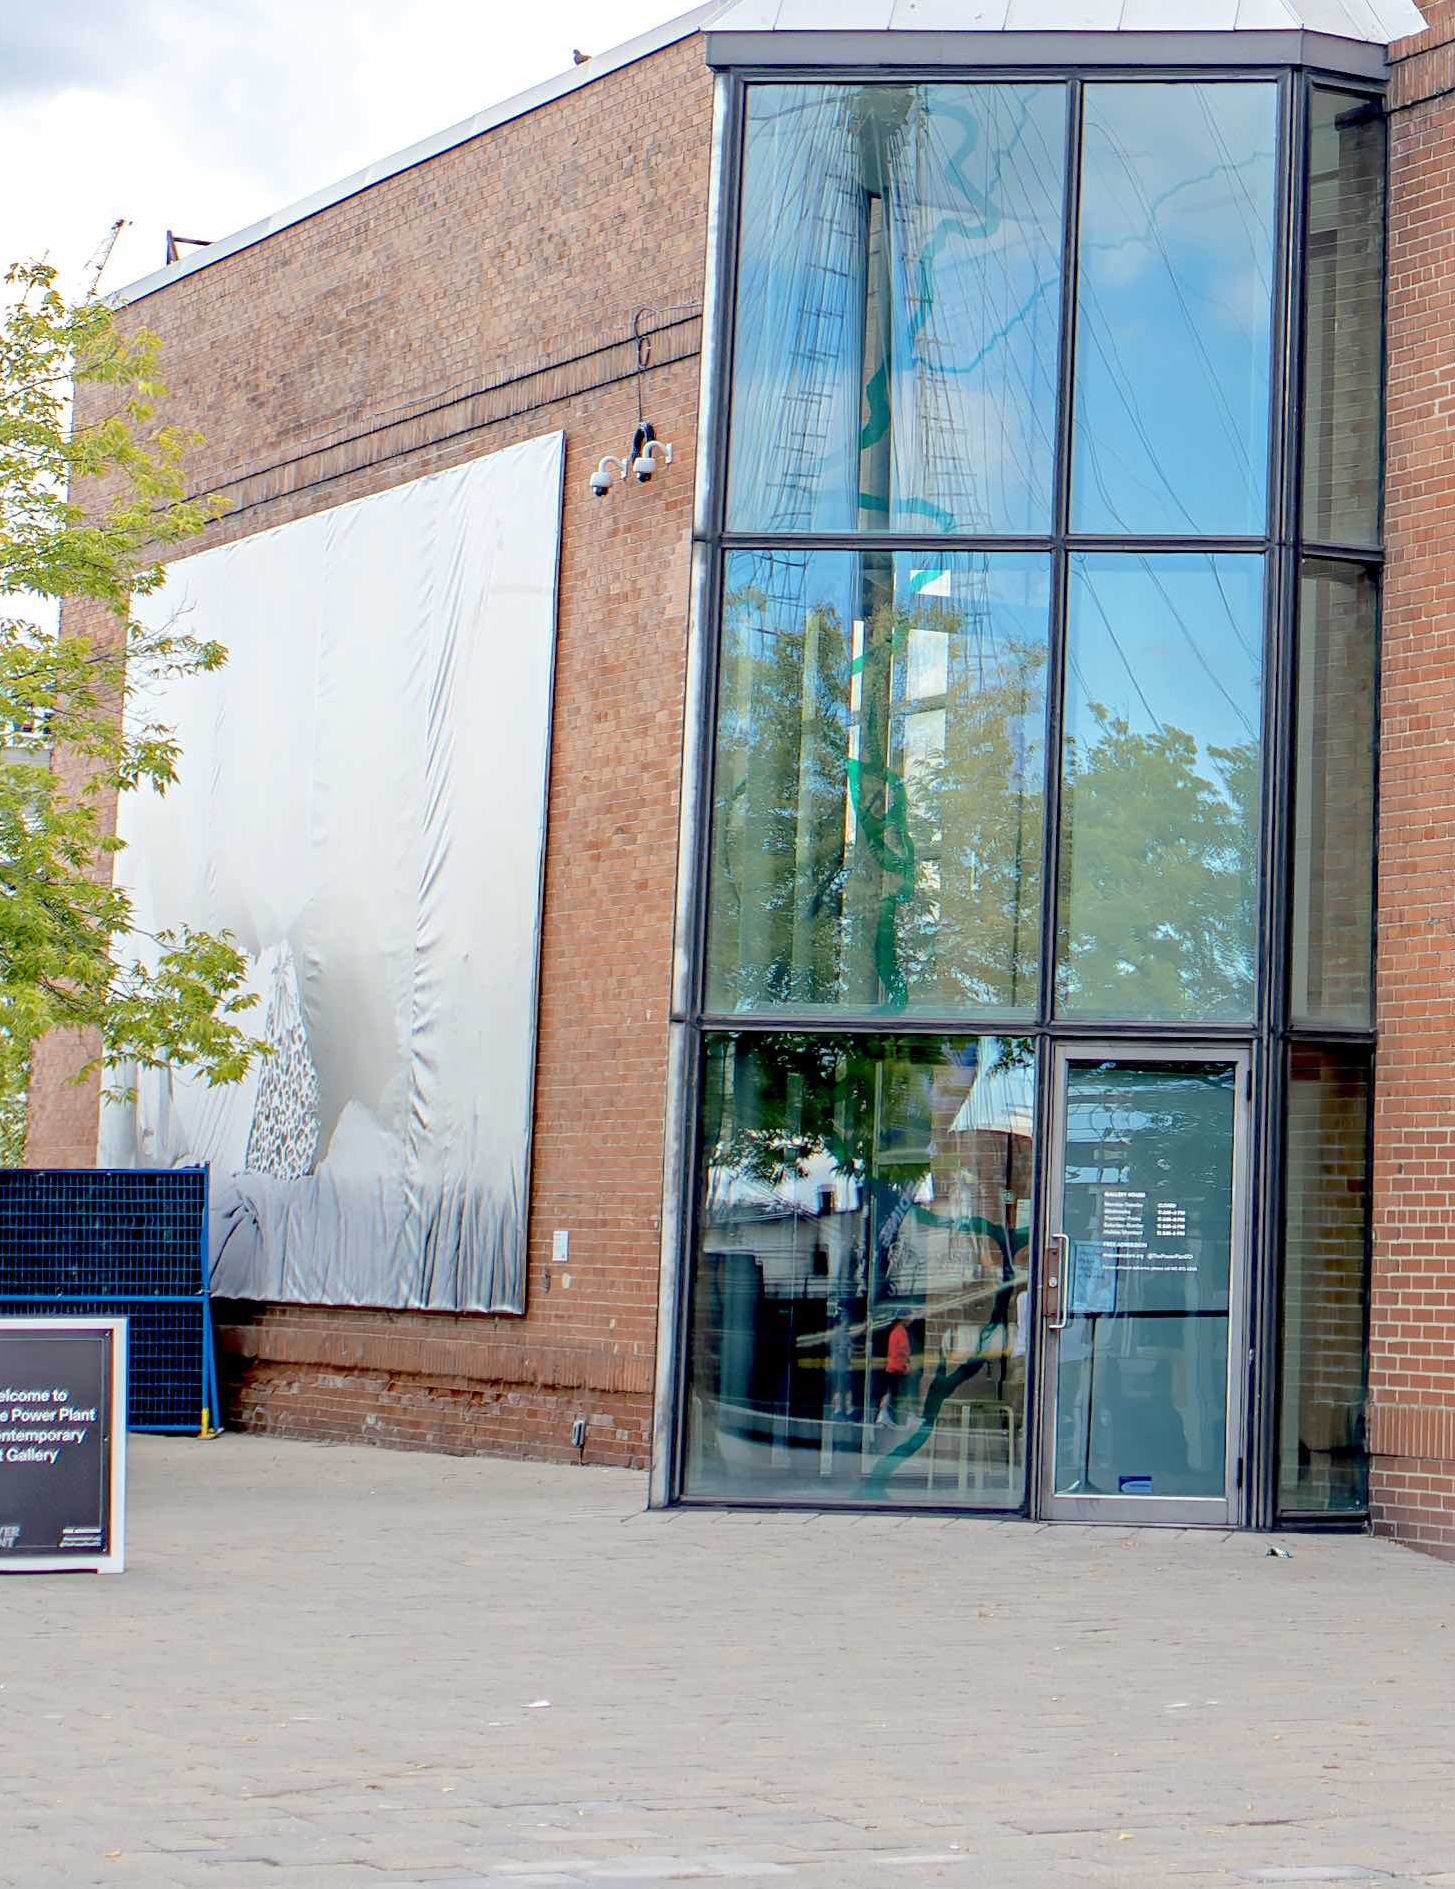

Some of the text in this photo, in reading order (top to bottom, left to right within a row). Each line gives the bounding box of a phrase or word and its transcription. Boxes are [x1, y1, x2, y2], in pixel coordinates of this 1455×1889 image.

[52, 1389, 68, 1403] to
[11, 1408, 58, 1423] Power
[59, 1408, 96, 1422] Plant
[6, 1447, 59, 1464] Gallery
